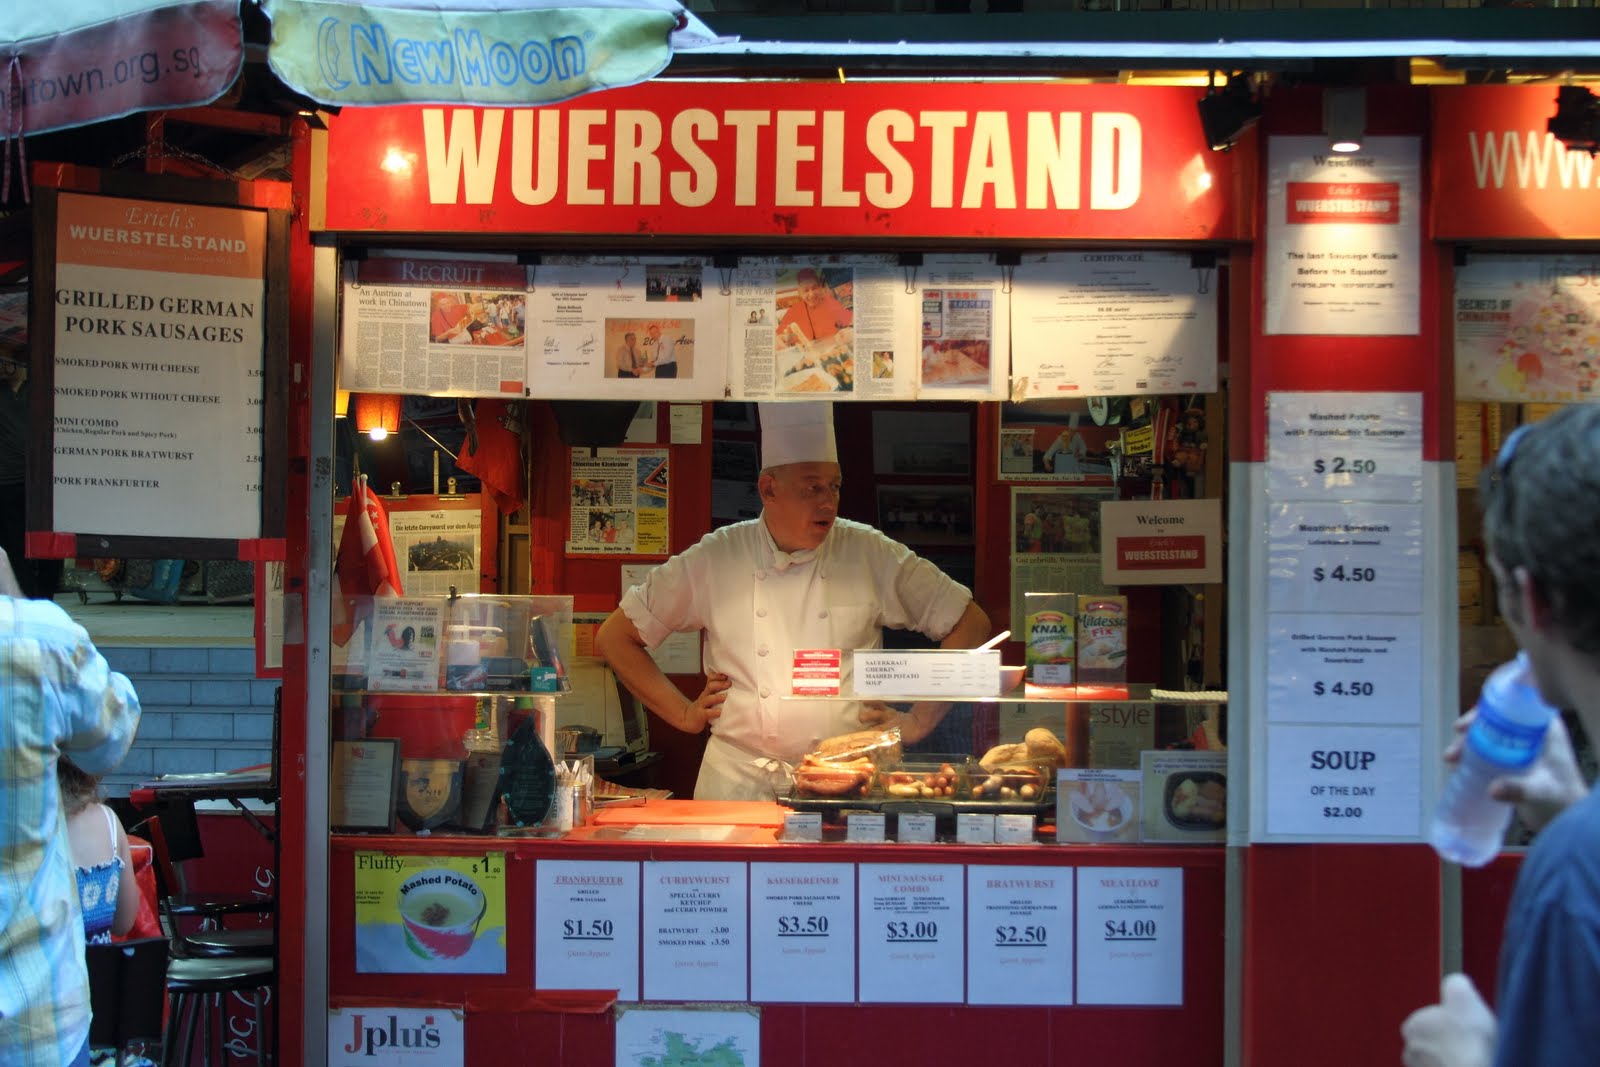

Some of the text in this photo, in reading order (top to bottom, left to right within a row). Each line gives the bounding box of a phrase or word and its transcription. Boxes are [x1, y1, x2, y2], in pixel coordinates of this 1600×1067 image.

[422, 108, 1142, 211] WUERSTELSTAND
[125, 206, 195, 229] Erich's
[69, 224, 247, 253] WUERSTELSTAND
[358, 288, 412, 298] An Austrian at
[55, 288, 254, 319] GRILLED GERMAN
[358, 298, 428, 308] work in Chinatown
[65, 316, 244, 344] PORK SAUSAGES
[55, 357, 200, 375] SMOKED PORK WITH CHEESE
[54, 387, 221, 405] SMOKED PORK WITHOUT CHEESE
[54, 417, 119, 428] MINI COMBO
[53, 446, 194, 461] GERMAN PORK BRATWURST
[1314, 456, 1377, 474] $ 2.50
[54, 476, 160, 489] PORK FRANKFURTER
[1136, 515, 1185, 525] Welcome
[418, 524, 446, 532] Currywurst
[1124, 550, 1198, 561] WUERSTELSTAND
[1313, 564, 1376, 582] $ 4.50
[1031, 624, 1068, 635] KNAX
[1091, 628, 1114, 638] Fix
[1313, 680, 1374, 697] $ 4.50
[1310, 750, 1376, 771] SOUP
[1310, 785, 1376, 797] OF THE DAY
[1323, 806, 1363, 818] $2.00
[357, 854, 404, 874] Fluffy
[400, 875, 478, 896] Mashed Potato
[555, 875, 624, 885] FRANKFURTER
[660, 876, 731, 885] CURRYWURST
[766, 877, 840, 886] KAESEKREINER
[878, 874, 945, 883] MINI SAUSAGE
[986, 879, 1056, 889] BRATWURST
[1100, 879, 1160, 888] MEATLOAF
[893, 884, 930, 894] COMBO
[563, 918, 614, 937] $1.50
[778, 915, 829, 934] $3.50
[886, 921, 938, 939] $3.00
[1105, 919, 1157, 938] $4.00
[995, 926, 1047, 943] $2.50
